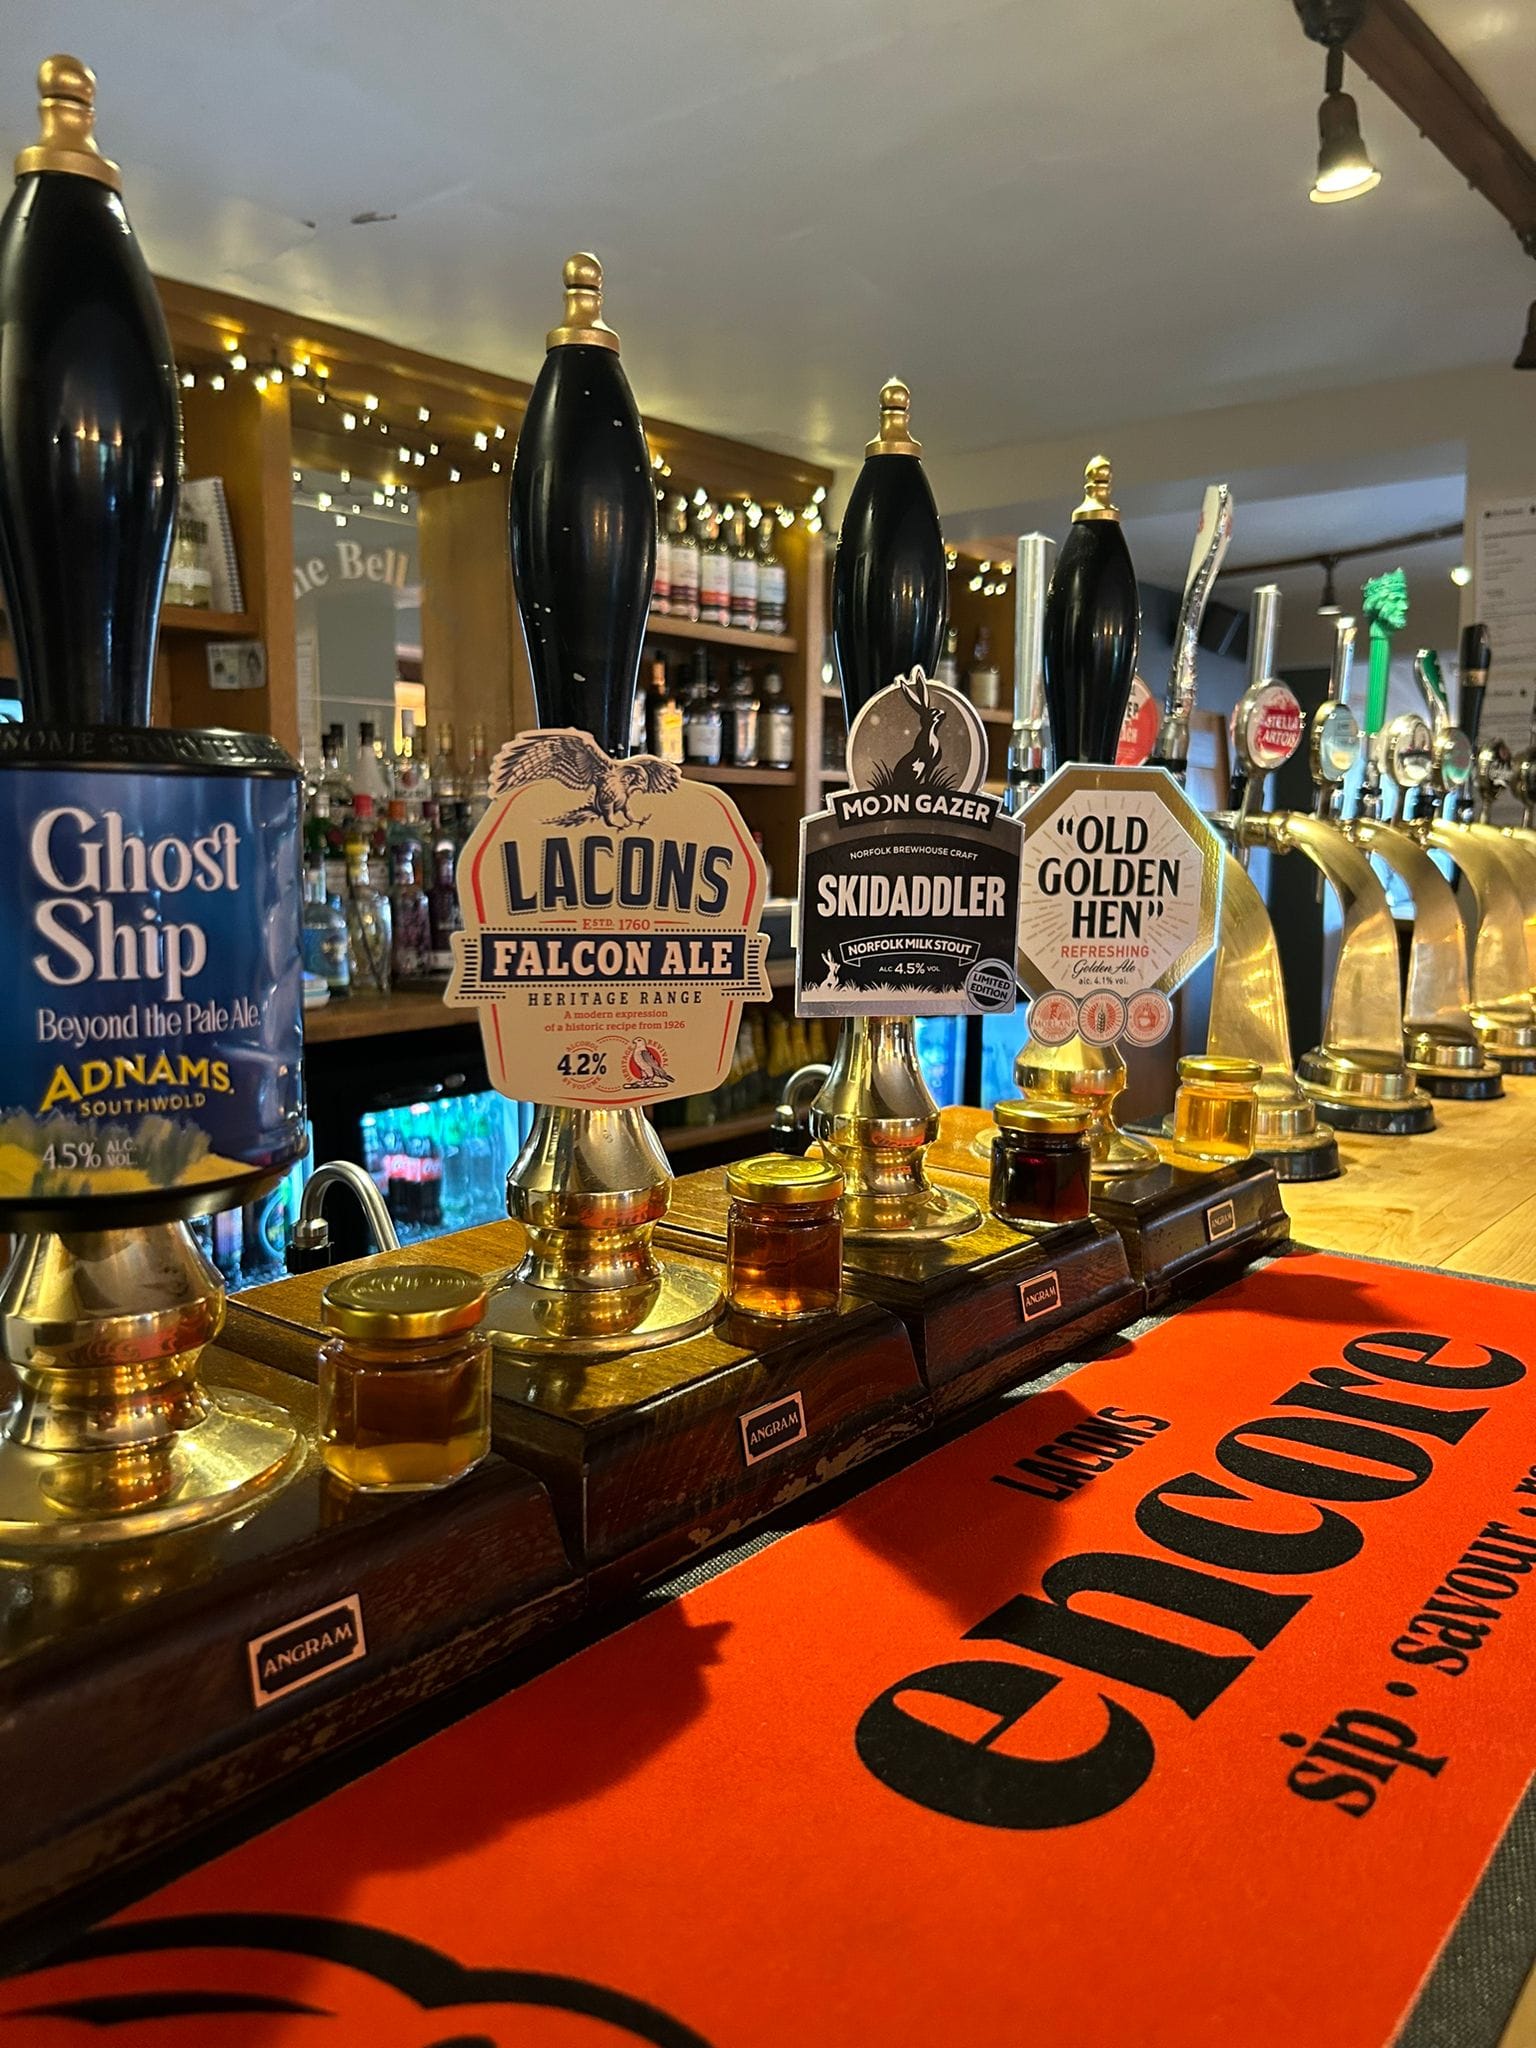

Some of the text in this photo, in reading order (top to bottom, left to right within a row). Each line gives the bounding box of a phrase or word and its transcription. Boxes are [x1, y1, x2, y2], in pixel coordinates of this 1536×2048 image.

[335, 539, 409, 590] Bell
[1265, 715, 1299, 731] STELLA
[915, 794, 991, 823] GAZER
[31, 806, 241, 894] Ghost
[850, 845, 979, 861] NORFOLK BREWHOUSE CRAFT
[502, 835, 734, 918] LACONS
[1037, 858, 1181, 897] GOLDEN
[817, 874, 1006, 918] SKIDADDLER
[618, 919, 650, 931] 1760
[34, 898, 208, 1001] Ship
[492, 940, 733, 977] FALCON ALE
[848, 938, 973, 957] NORFOLK MILK STOUT
[1060, 945, 1150, 958] REFRESHING
[894, 962, 926, 974] 4.5%
[1072, 959, 1112, 979] Golden
[1094, 976, 1113, 985] 4.1%
[970, 983, 1008, 1000] EDITION
[973, 973, 1010, 991] LIMITED
[528, 990, 703, 1007] HERITAGE RANGE
[37, 1004, 138, 1048] Beyond
[144, 1005, 182, 1037] the
[185, 1000, 228, 1034] Pale
[544, 1020, 686, 1032] of a historic recipe from 1926
[563, 1009, 669, 1021] A modern expression
[557, 1052, 607, 1077] 4.2%
[80, 1093, 206, 1118] SOUTHWOLD
[42, 1142, 101, 1170] 4.5%
[1025, 1285, 1056, 1307] ANGRAM
[750, 1412, 798, 1446] ANGRAM
[991, 1405, 1172, 1503] LACONS
[854, 1330, 1528, 1831] encore
[263, 1622, 353, 1679] ANGRAM
[1279, 1521, 1536, 1819] sip savour
